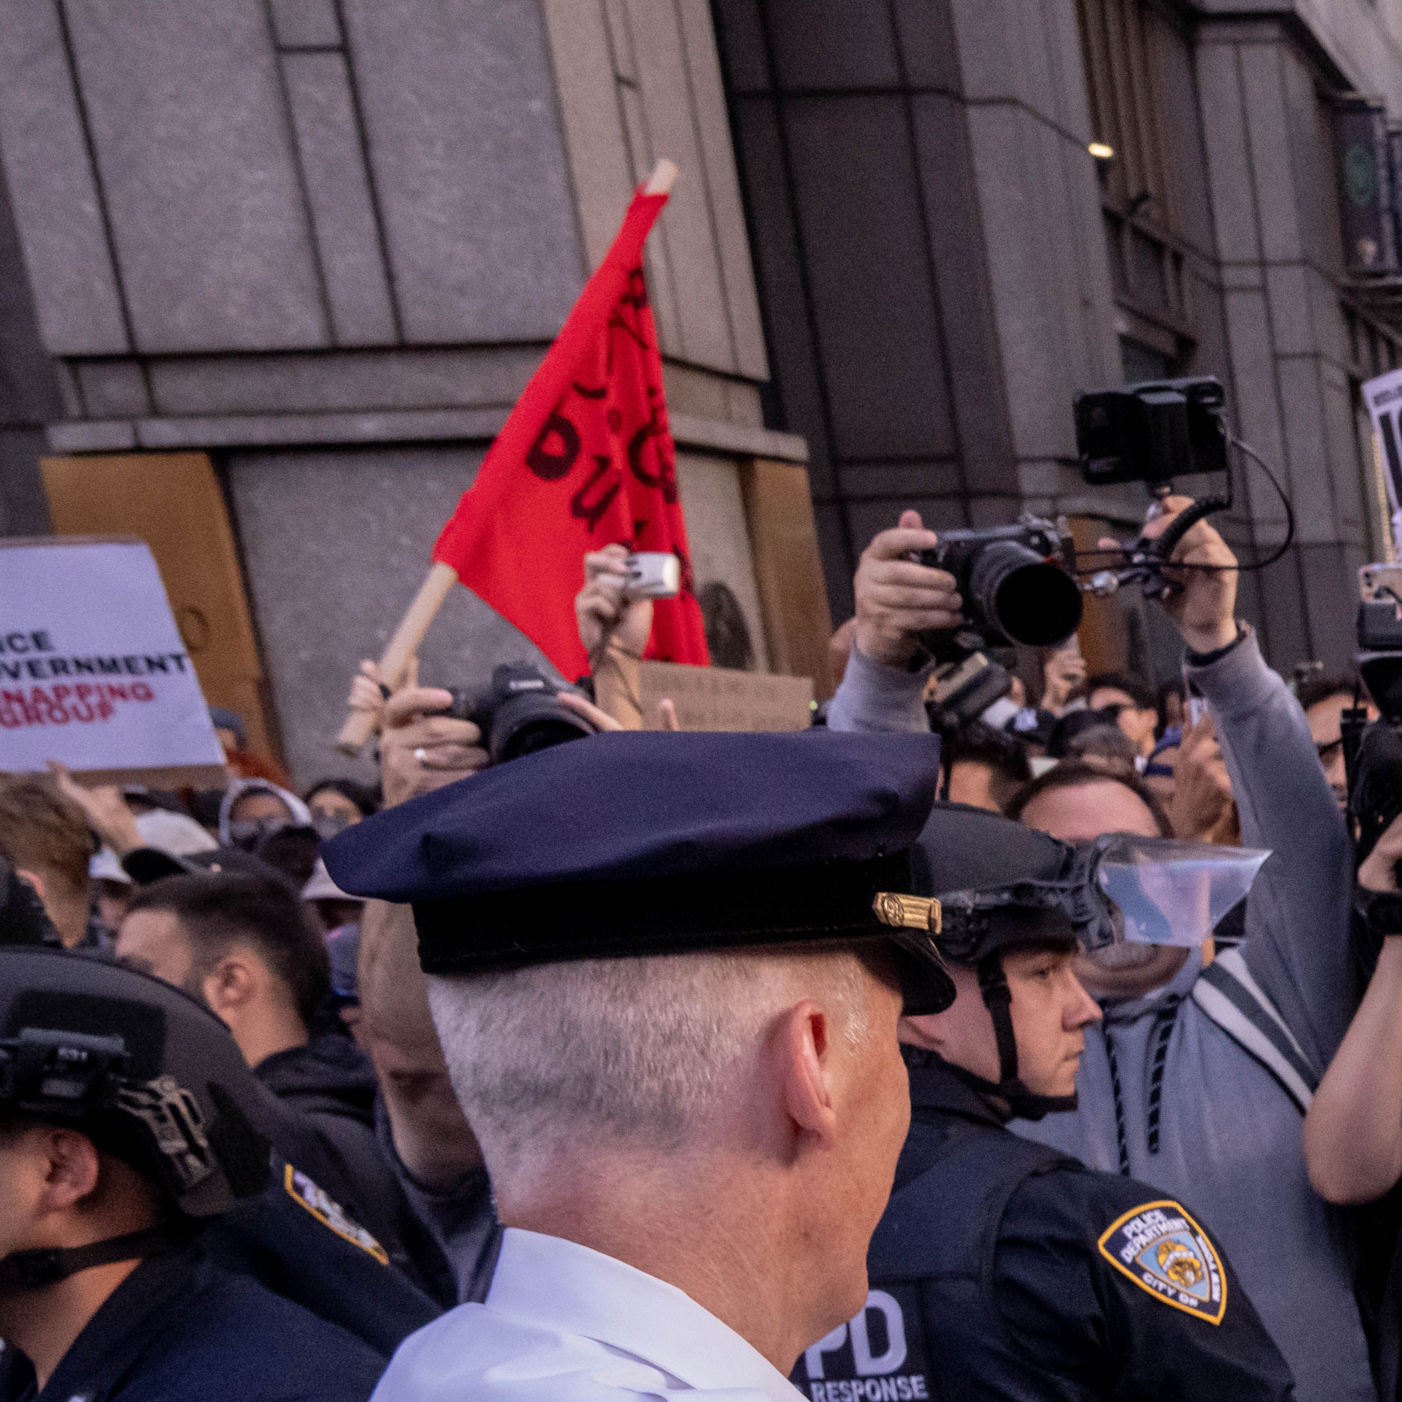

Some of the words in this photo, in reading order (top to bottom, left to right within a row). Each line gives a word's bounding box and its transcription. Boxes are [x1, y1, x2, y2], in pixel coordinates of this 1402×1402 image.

[0, 653, 188, 680] VERNMENT
[1, 681, 156, 705] NAPPING
[1121, 1208, 1169, 1241] POLICE
[1141, 1271, 1177, 1297] CITY
[1177, 1293, 1199, 1308] OF
[804, 1289, 908, 1380] PD
